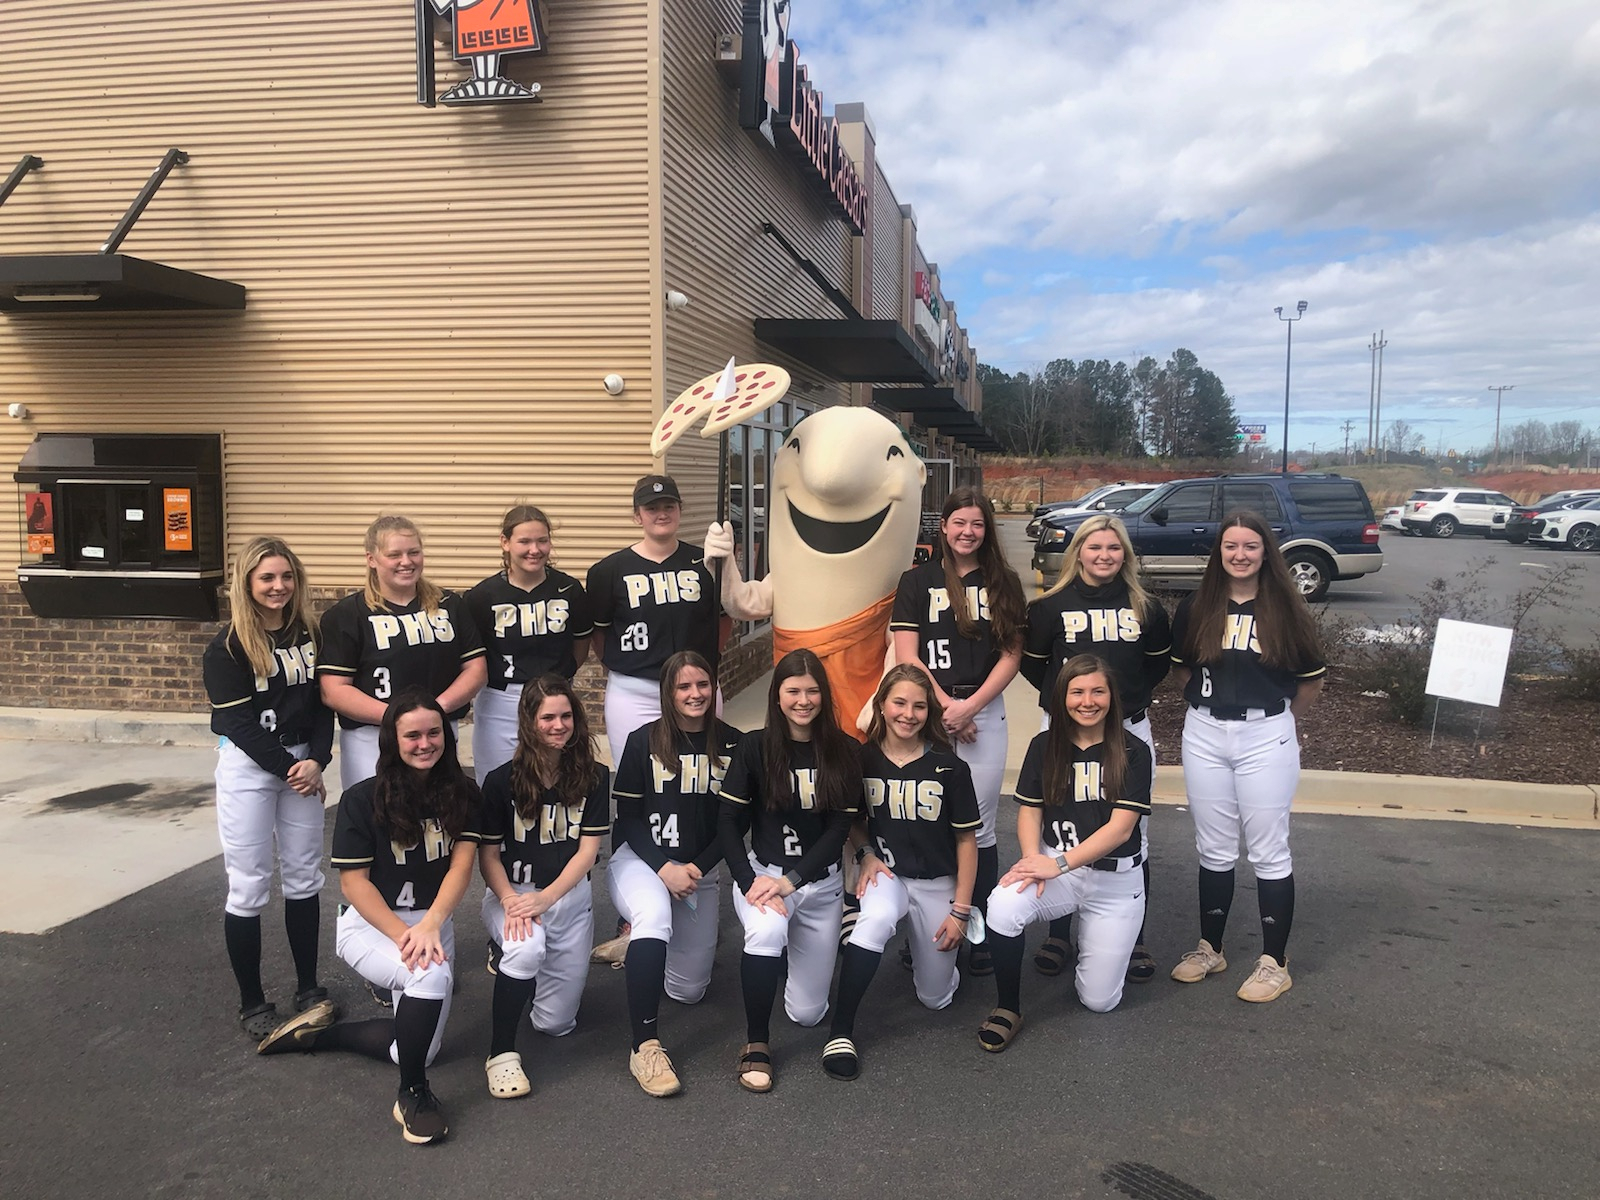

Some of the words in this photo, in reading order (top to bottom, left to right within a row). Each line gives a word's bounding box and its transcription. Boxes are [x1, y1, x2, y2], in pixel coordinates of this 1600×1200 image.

[790, 39, 828, 180] Little
[829, 116, 868, 236] Caesars
[623, 570, 701, 610] PHS
[368, 608, 456, 650] PHS
[491, 599, 570, 638] PHS
[1061, 608, 1141, 643] PHS
[621, 621, 649, 651] 28
[927, 639, 952, 669] 15
[373, 667, 391, 699] 3
[1201, 667, 1213, 697] 6
[863, 778, 944, 821] PHS
[649, 813, 679, 847] 24
[783, 824, 802, 856] 2
[512, 860, 532, 883] 11
[396, 881, 417, 907] 4
